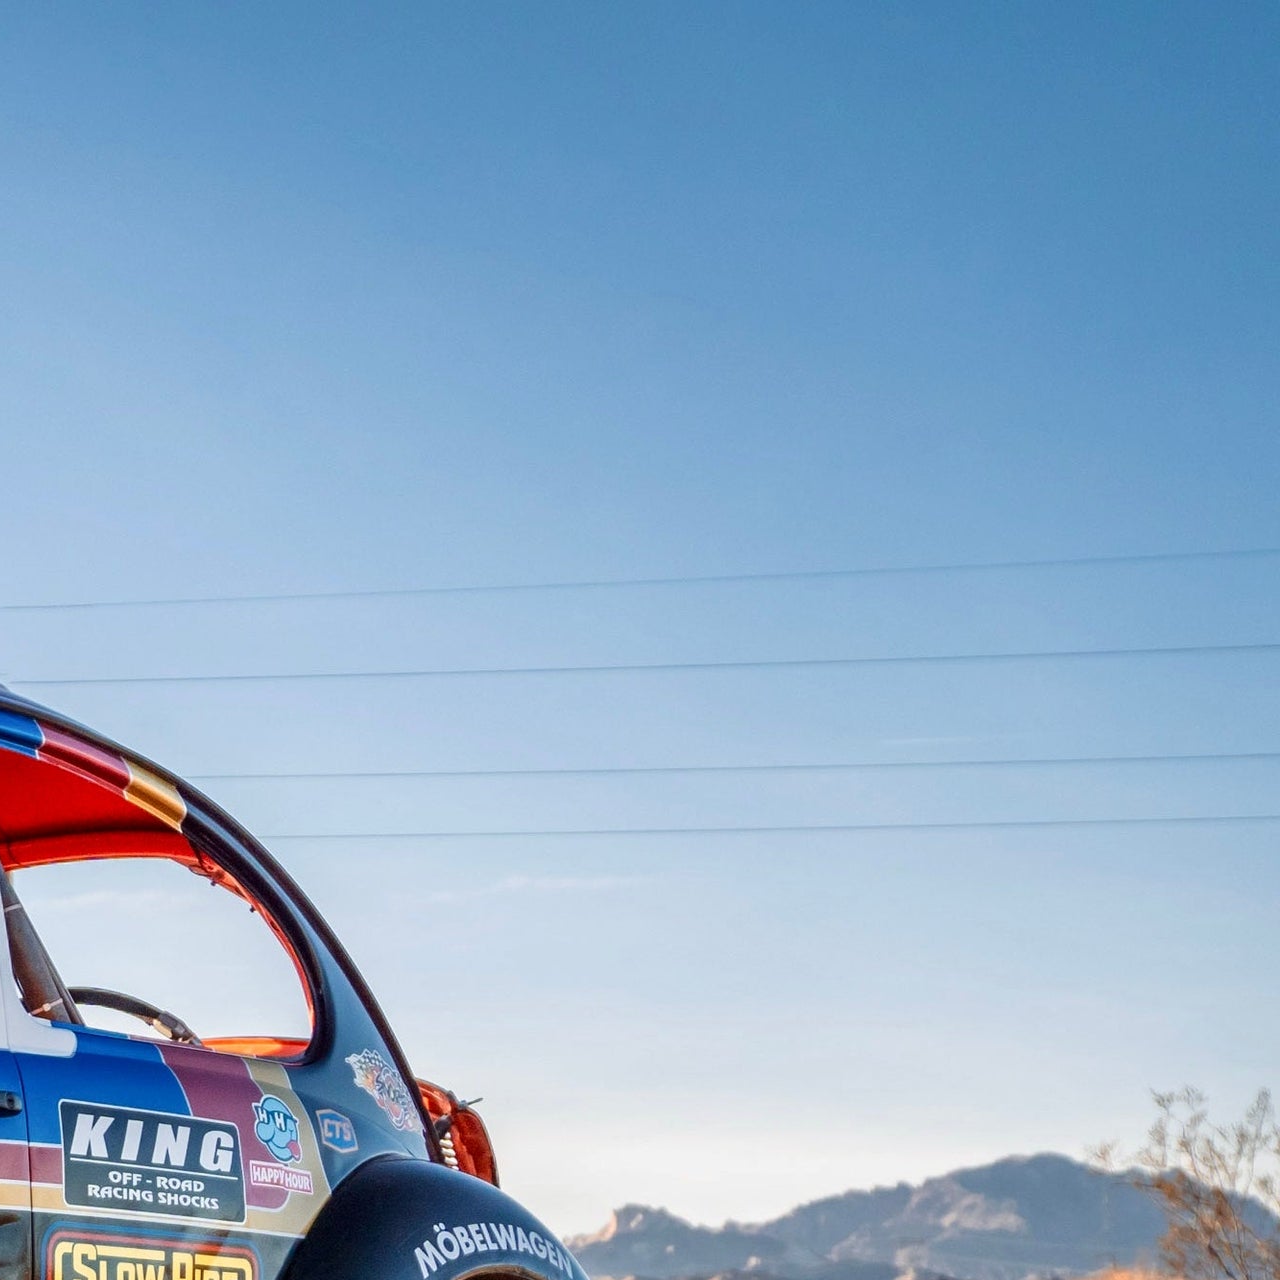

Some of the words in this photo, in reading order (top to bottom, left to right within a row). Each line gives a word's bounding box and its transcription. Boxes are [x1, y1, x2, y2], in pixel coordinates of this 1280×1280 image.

[323, 1118, 352, 1141] CTS
[70, 1113, 235, 1173] KING
[108, 1170, 143, 1187] OFF
[156, 1176, 205, 1193] ROAD
[252, 1165, 285, 1185] HAPPY
[284, 1171, 312, 1191] HOUR
[87, 1184, 154, 1203] RACING
[157, 1192, 220, 1210] SHOCKS
[414, 1222, 574, 1280] MÖBELWAGEN
